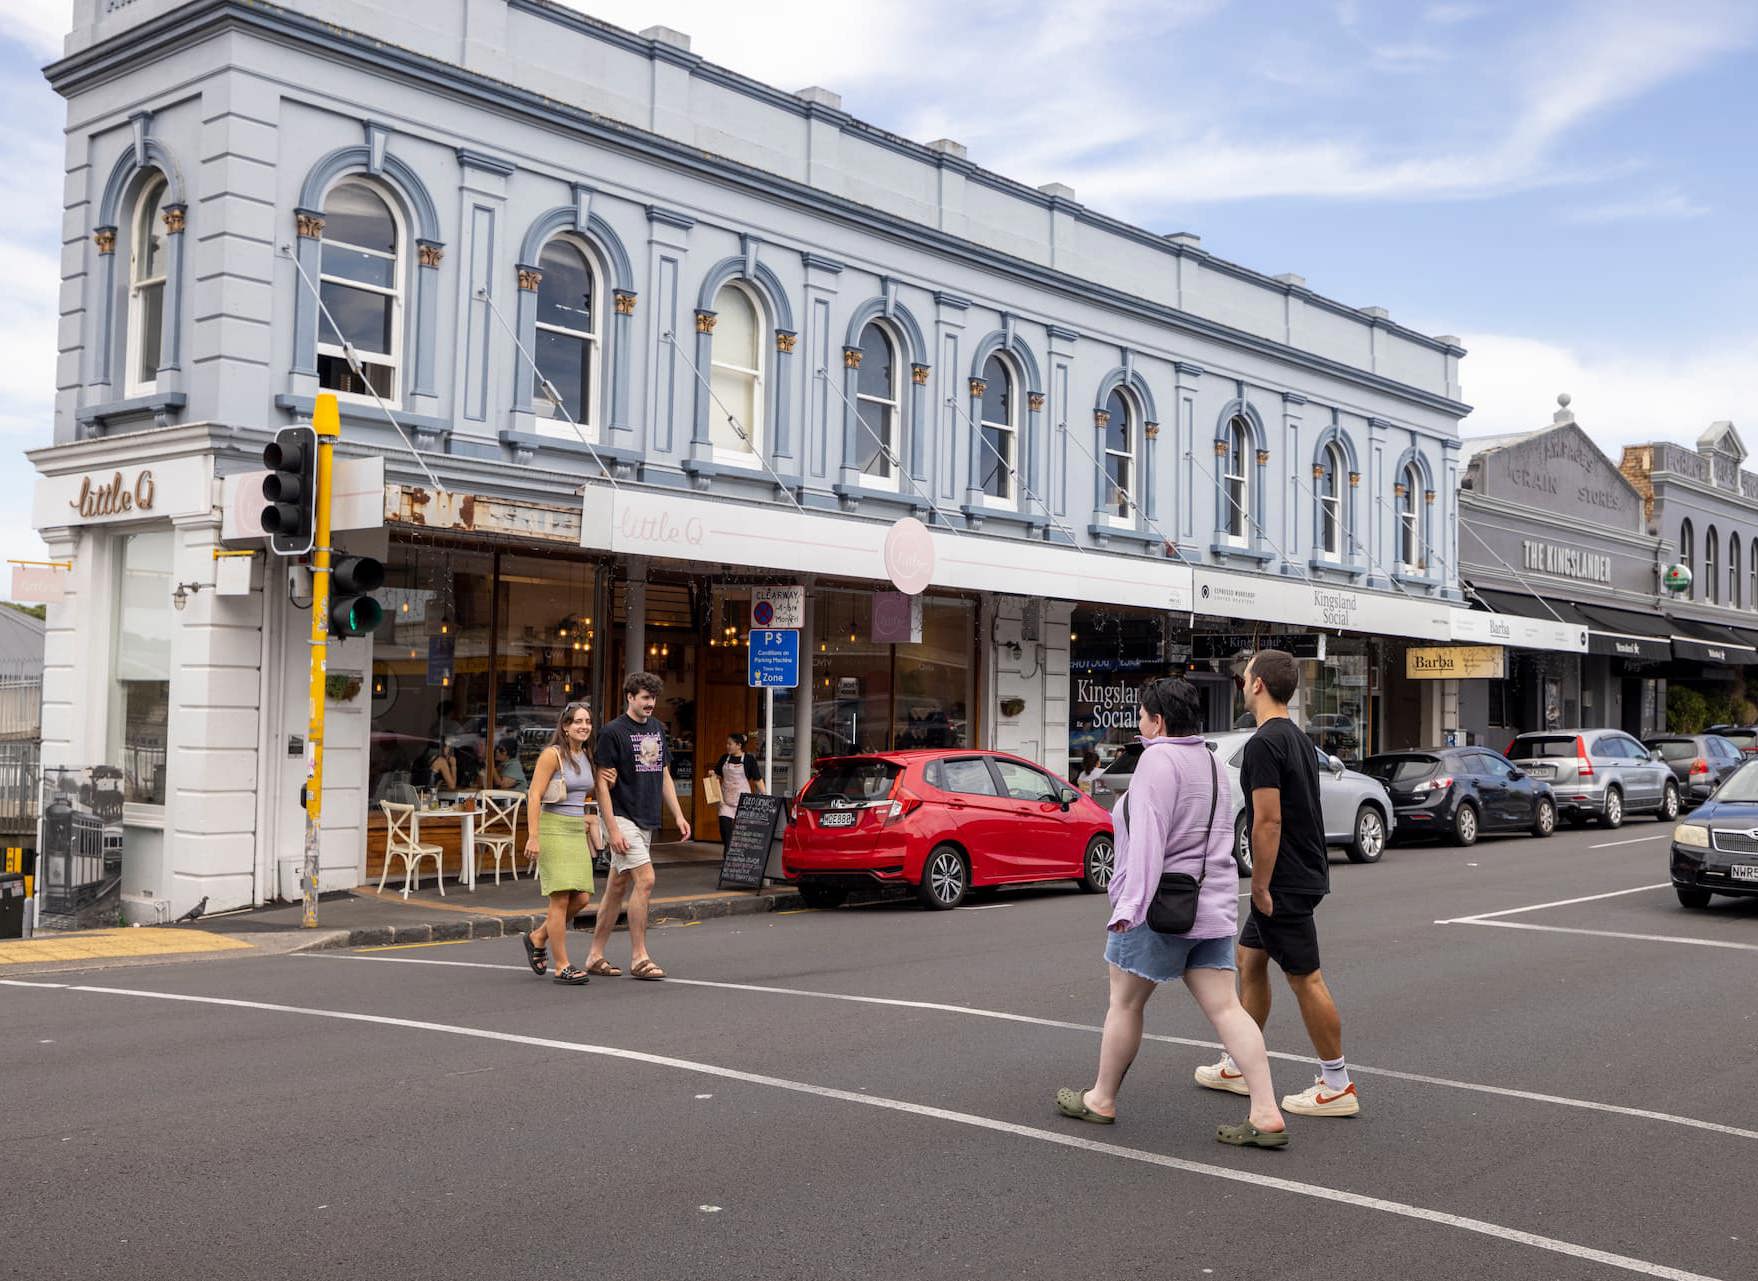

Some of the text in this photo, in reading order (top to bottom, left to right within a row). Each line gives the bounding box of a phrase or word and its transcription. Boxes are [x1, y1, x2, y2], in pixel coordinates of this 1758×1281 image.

[69, 470, 154, 518] little Q
[1523, 540, 1612, 583] THE KINGSLANDER
[756, 591, 800, 600] CLEARWAY
[1314, 590, 1357, 611] Kingsland
[1322, 608, 1350, 625] Social
[764, 631, 774, 646] P
[1415, 655, 1455, 669] Barba
[762, 672, 784, 682] Zone
[1093, 704, 1137, 728] Social
